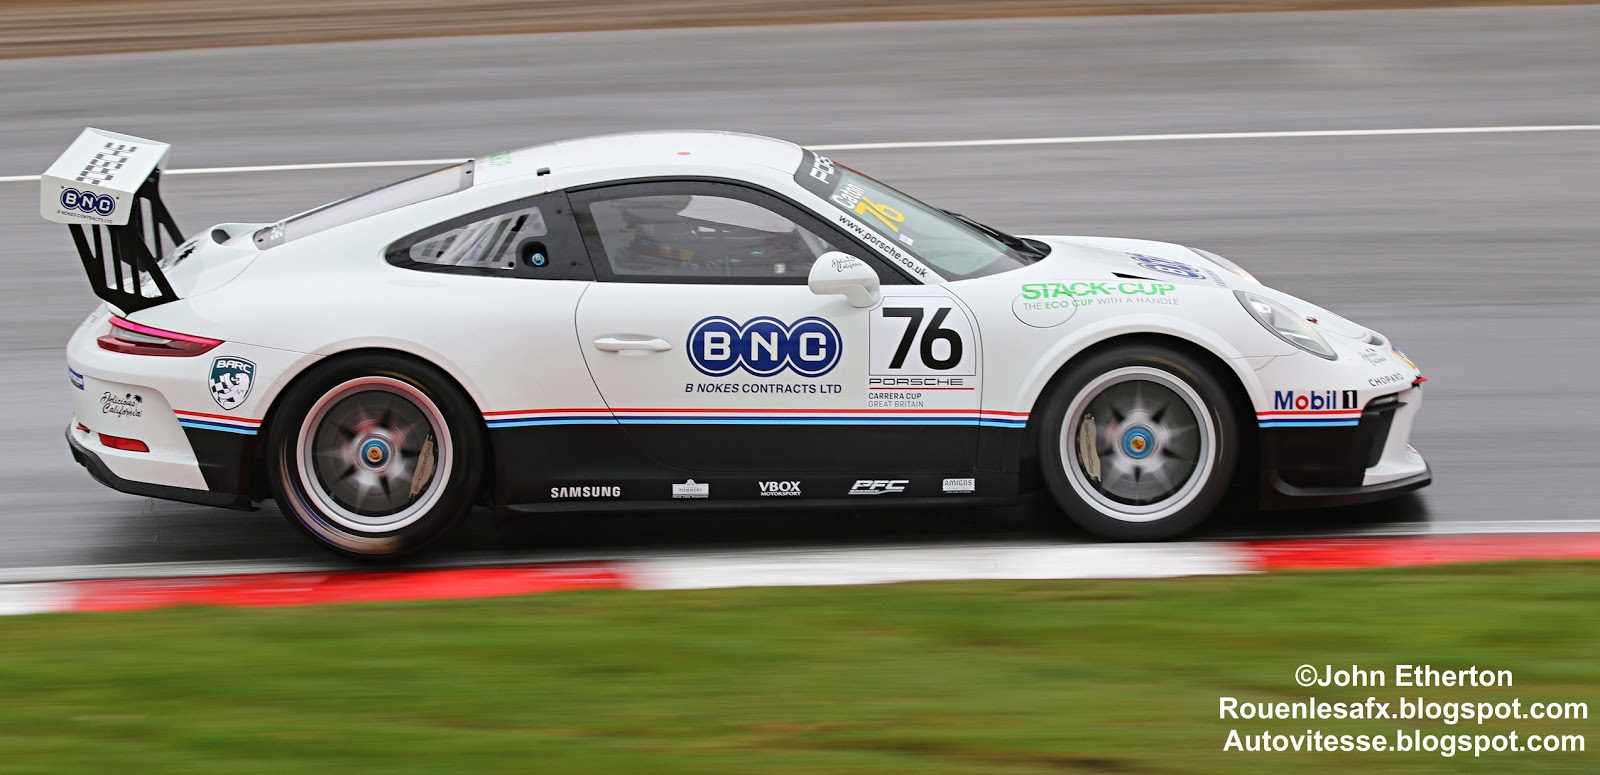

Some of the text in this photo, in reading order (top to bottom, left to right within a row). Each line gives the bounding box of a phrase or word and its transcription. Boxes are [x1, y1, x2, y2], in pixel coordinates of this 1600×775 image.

[831, 183, 864, 210] Caton
[854, 195, 905, 233] 76
[839, 215, 928, 278] www.porsche.co.uk
[1021, 281, 1176, 300] STACK-CUP
[1023, 302, 1043, 311] THE
[1045, 301, 1069, 310] ECO
[1072, 298, 1094, 307] CUP
[1097, 297, 1123, 305] WITH
[1137, 297, 1181, 306] HANDLE
[882, 307, 963, 371] 76
[216, 360, 252, 374] BARC
[868, 378, 964, 386] PORSCHE
[1368, 372, 1405, 387] CHOPARD
[685, 383, 842, 394] B NOKES CONTRACTS LTD
[100, 391, 136, 407] Delicious
[868, 392, 922, 400] CARRERA CUP
[1274, 390, 1337, 411] Mobil
[103, 402, 143, 418] California
[868, 400, 924, 408] GREAT BRITAIN
[758, 481, 801, 492] VBOX
[851, 479, 910, 490] PFC
[944, 479, 973, 487] AMIGOS
[550, 486, 621, 498] SAMSUNG
